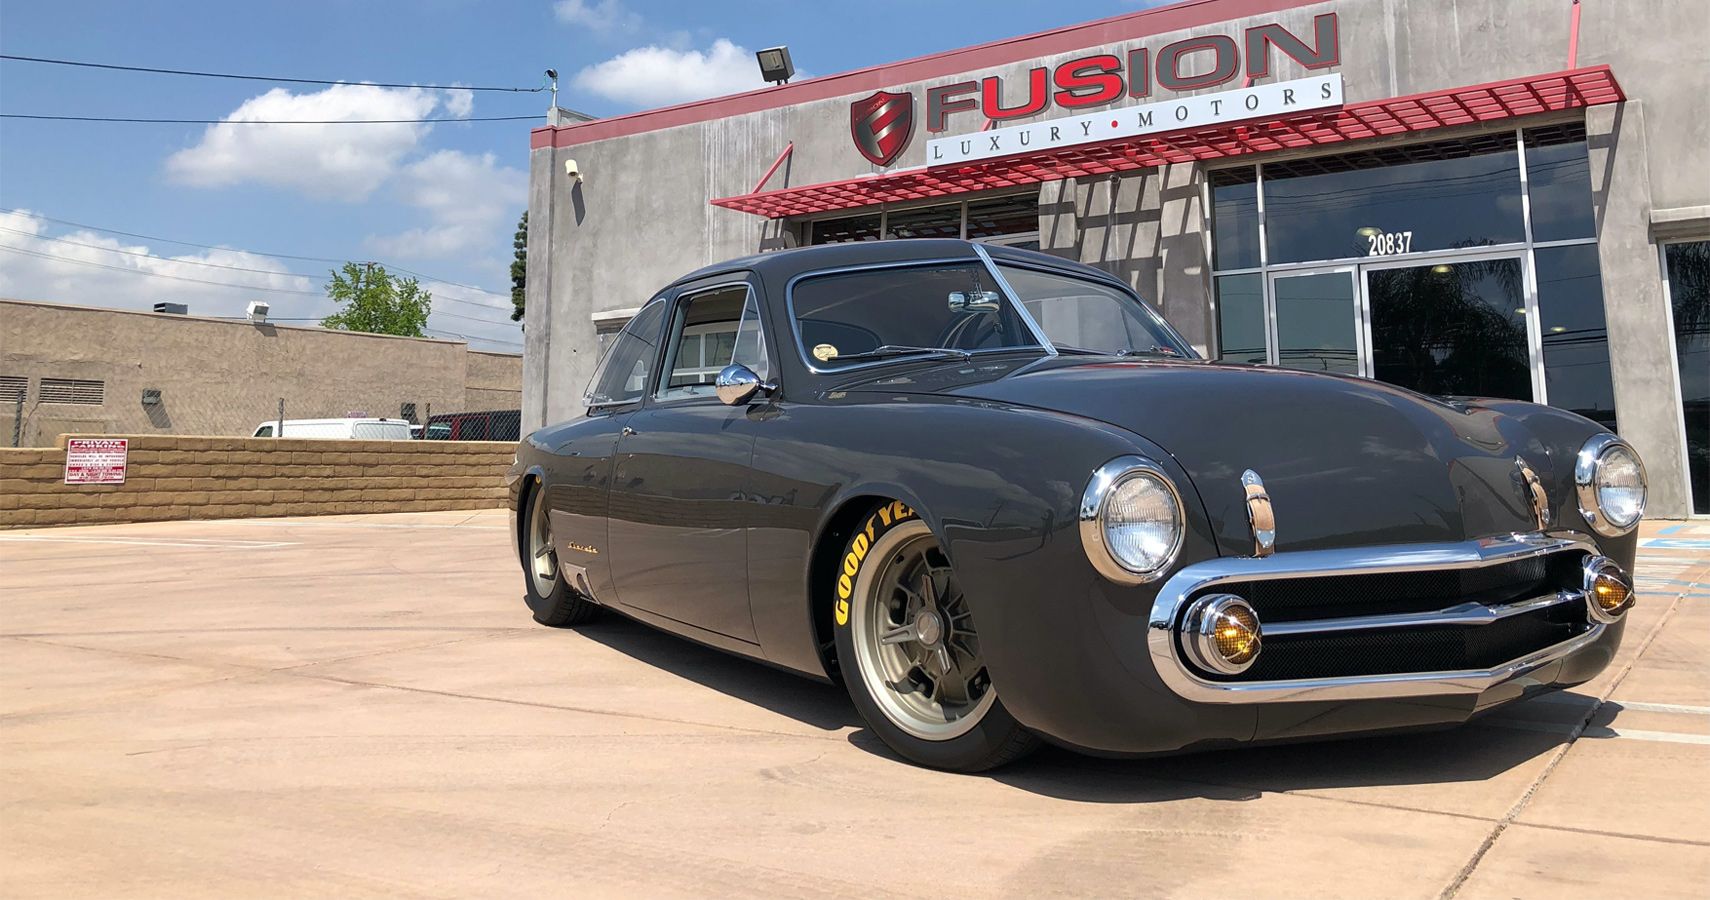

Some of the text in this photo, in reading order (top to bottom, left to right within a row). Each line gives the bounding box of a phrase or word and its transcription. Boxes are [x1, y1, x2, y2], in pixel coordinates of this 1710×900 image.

[927, 12, 1340, 133] FUSION
[933, 82, 1332, 160] LUXURY MOTORS
[1368, 231, 1412, 256] 20837
